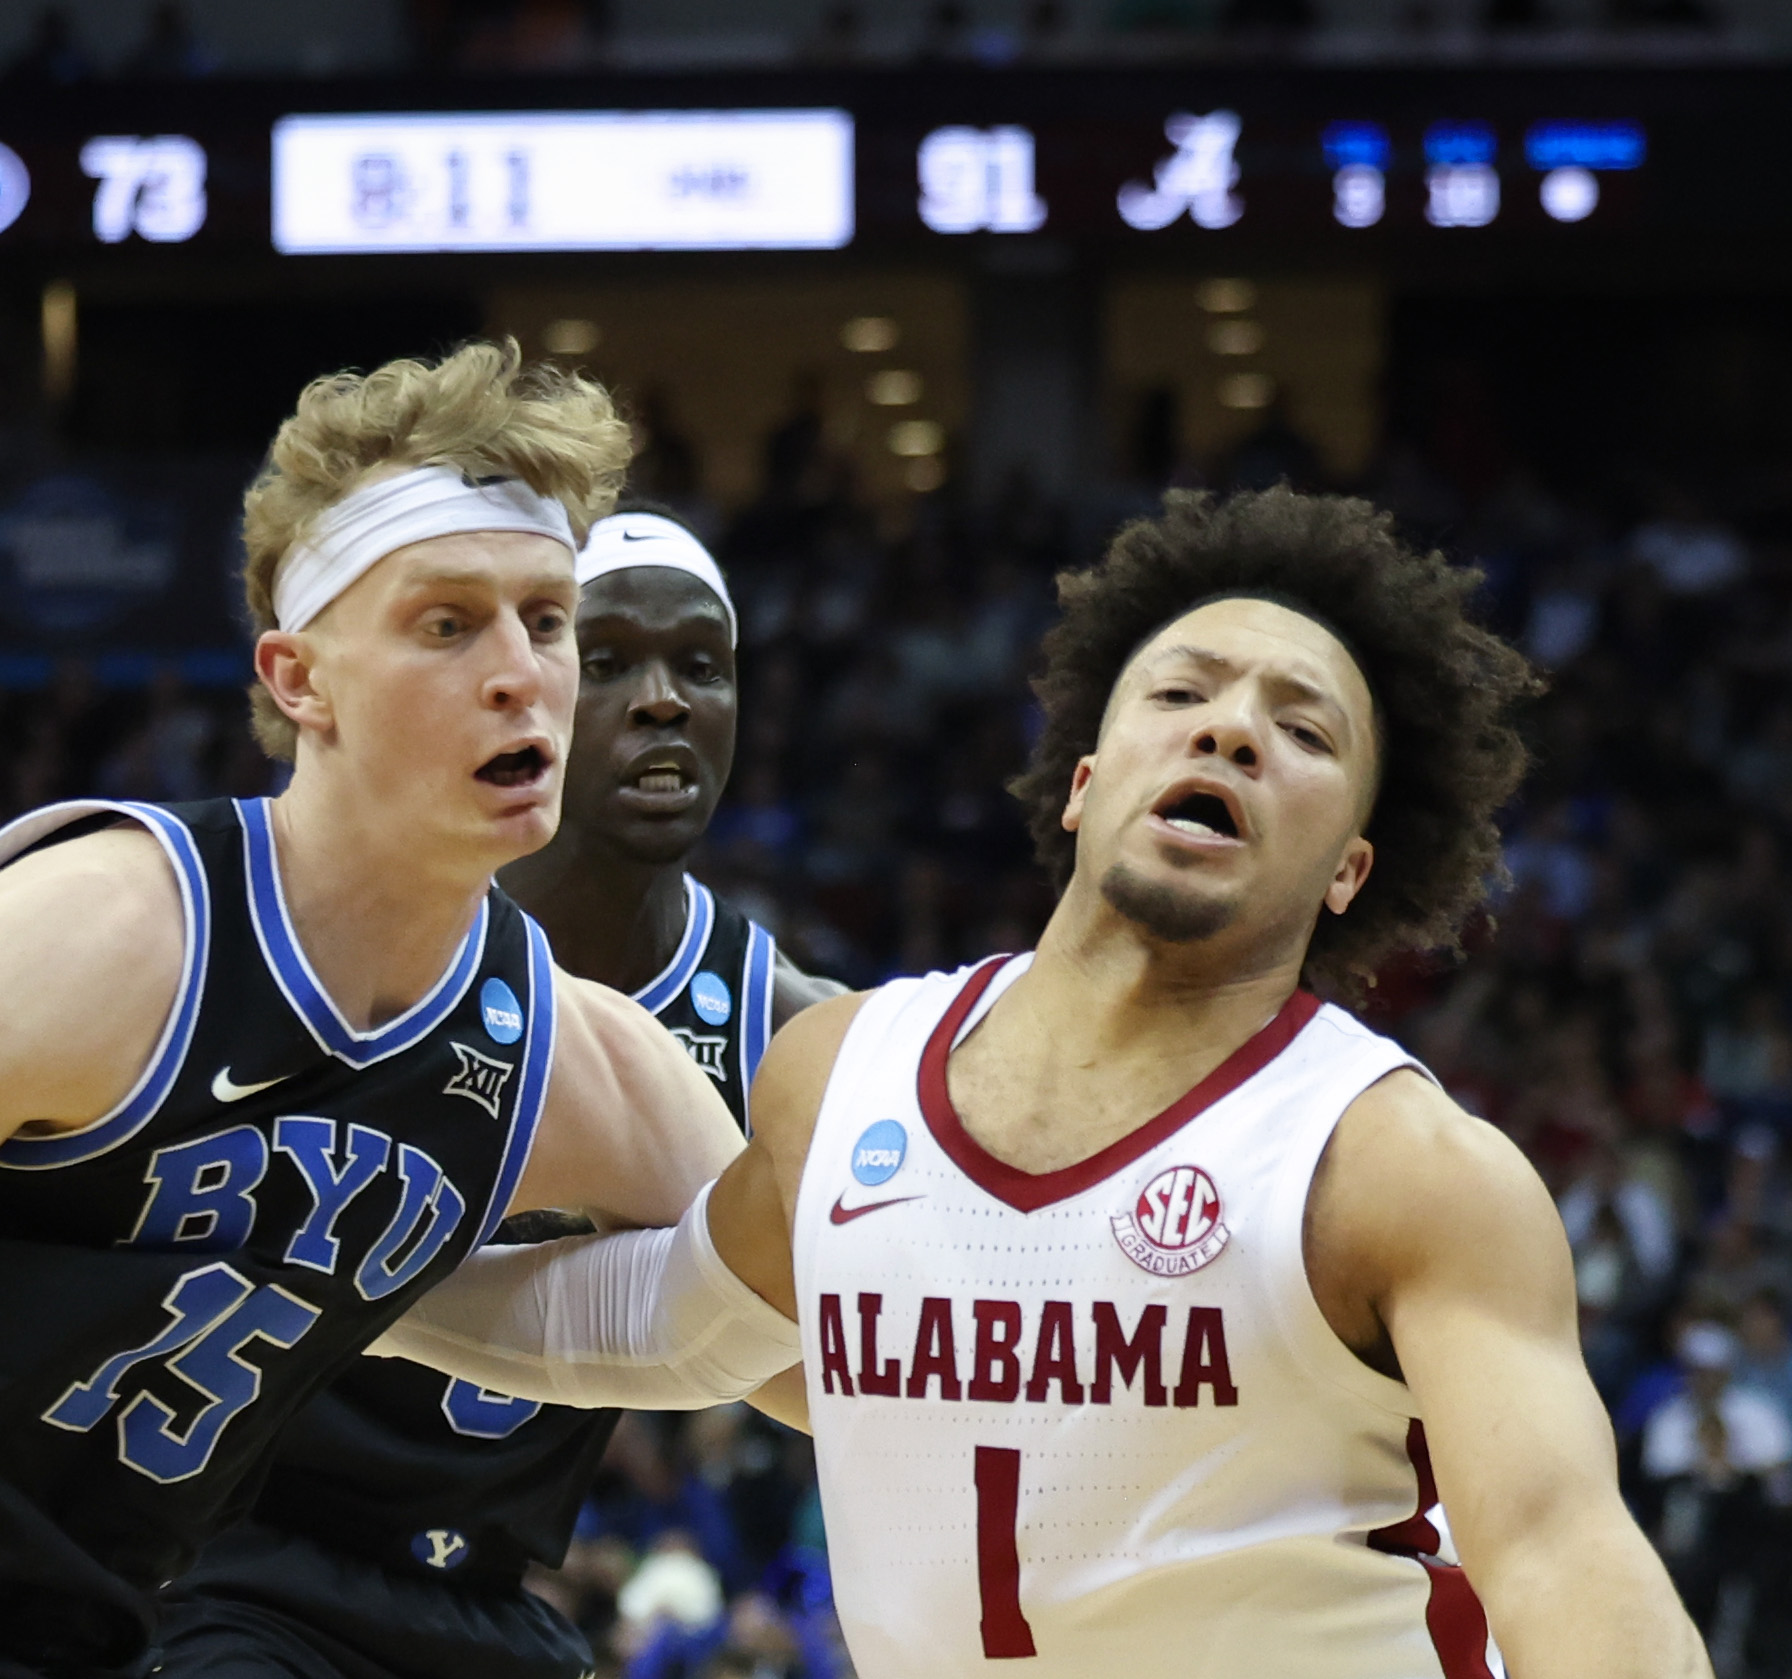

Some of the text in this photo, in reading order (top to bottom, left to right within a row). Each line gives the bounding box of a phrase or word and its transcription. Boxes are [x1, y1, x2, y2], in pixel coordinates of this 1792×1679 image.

[80, 134, 207, 243] 73
[917, 124, 1047, 235] 91
[485, 1007, 523, 1029] NCAA
[696, 994, 730, 1014] NCAA
[115, 1116, 465, 1300] BYU
[856, 1149, 901, 1167] NCAA
[1140, 1168, 1217, 1246] SEC
[1120, 1234, 1214, 1274] GRADUATE
[42, 1261, 322, 1483] 15
[819, 1292, 1239, 1408] ALABAMA
[974, 1445, 1037, 1659] 1
